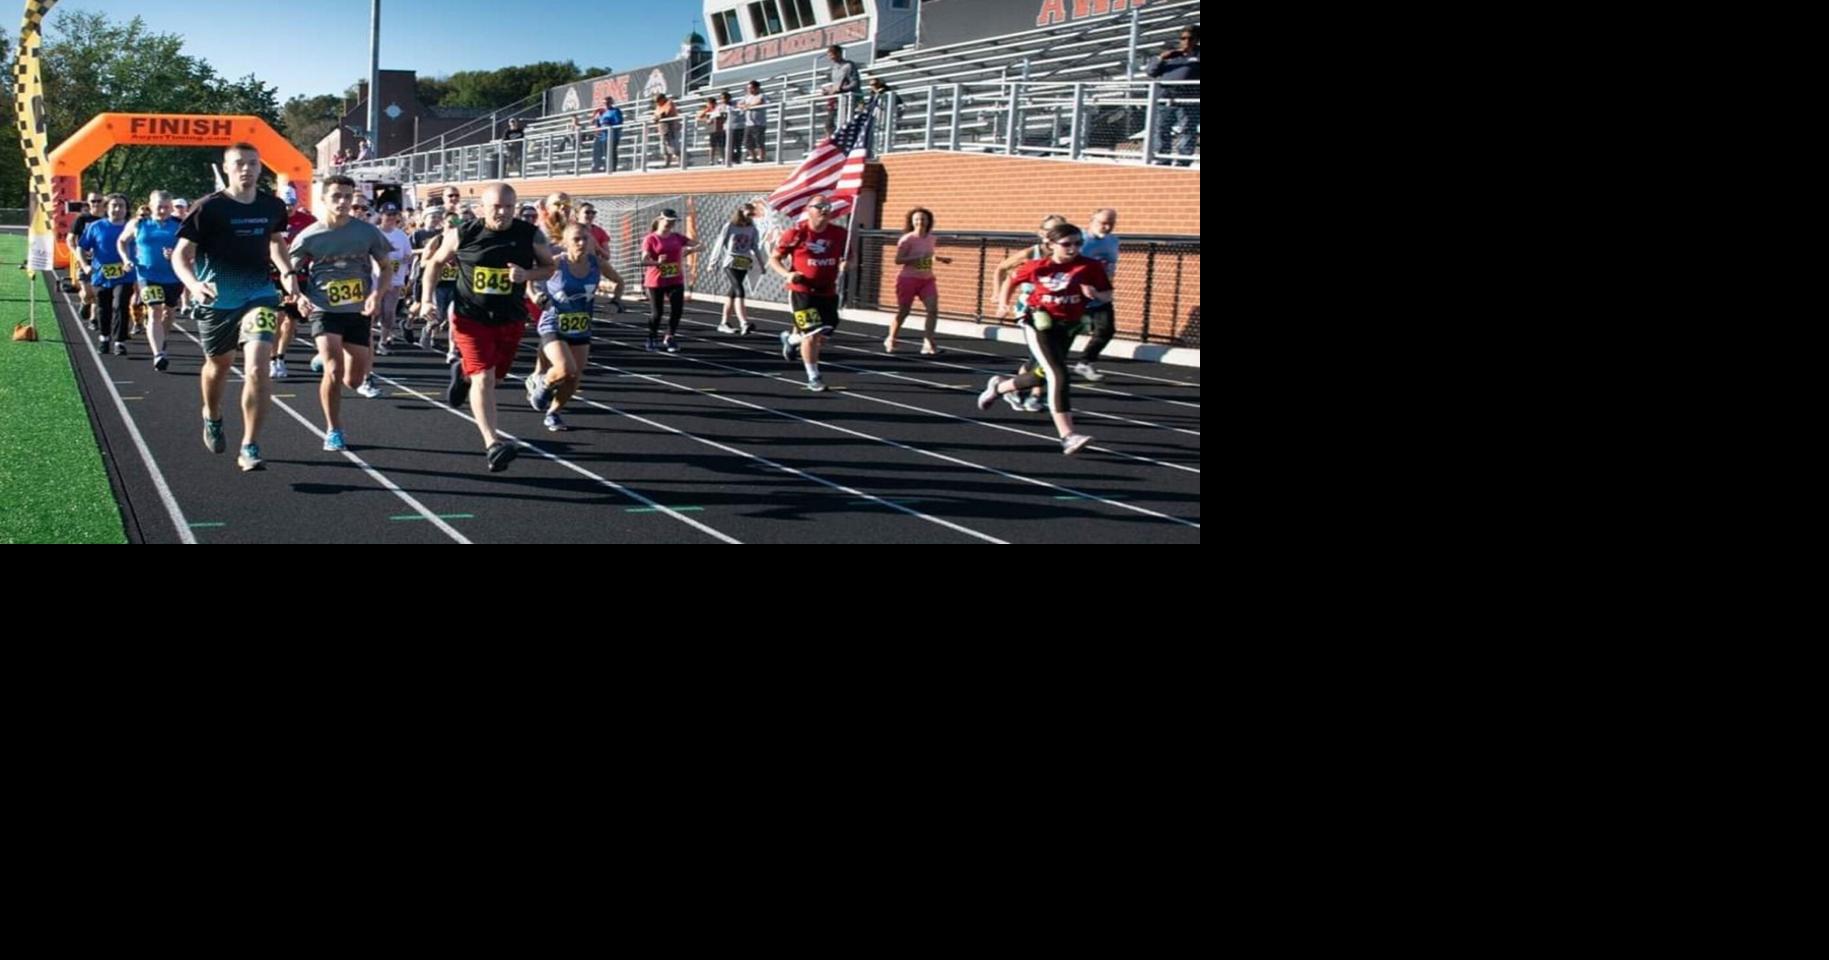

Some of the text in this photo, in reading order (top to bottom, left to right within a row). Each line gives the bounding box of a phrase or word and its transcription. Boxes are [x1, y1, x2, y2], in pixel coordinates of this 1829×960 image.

[130, 117, 233, 136] FINISH
[475, 271, 511, 292] 845
[329, 284, 362, 303] 834
[560, 315, 590, 332] 820
